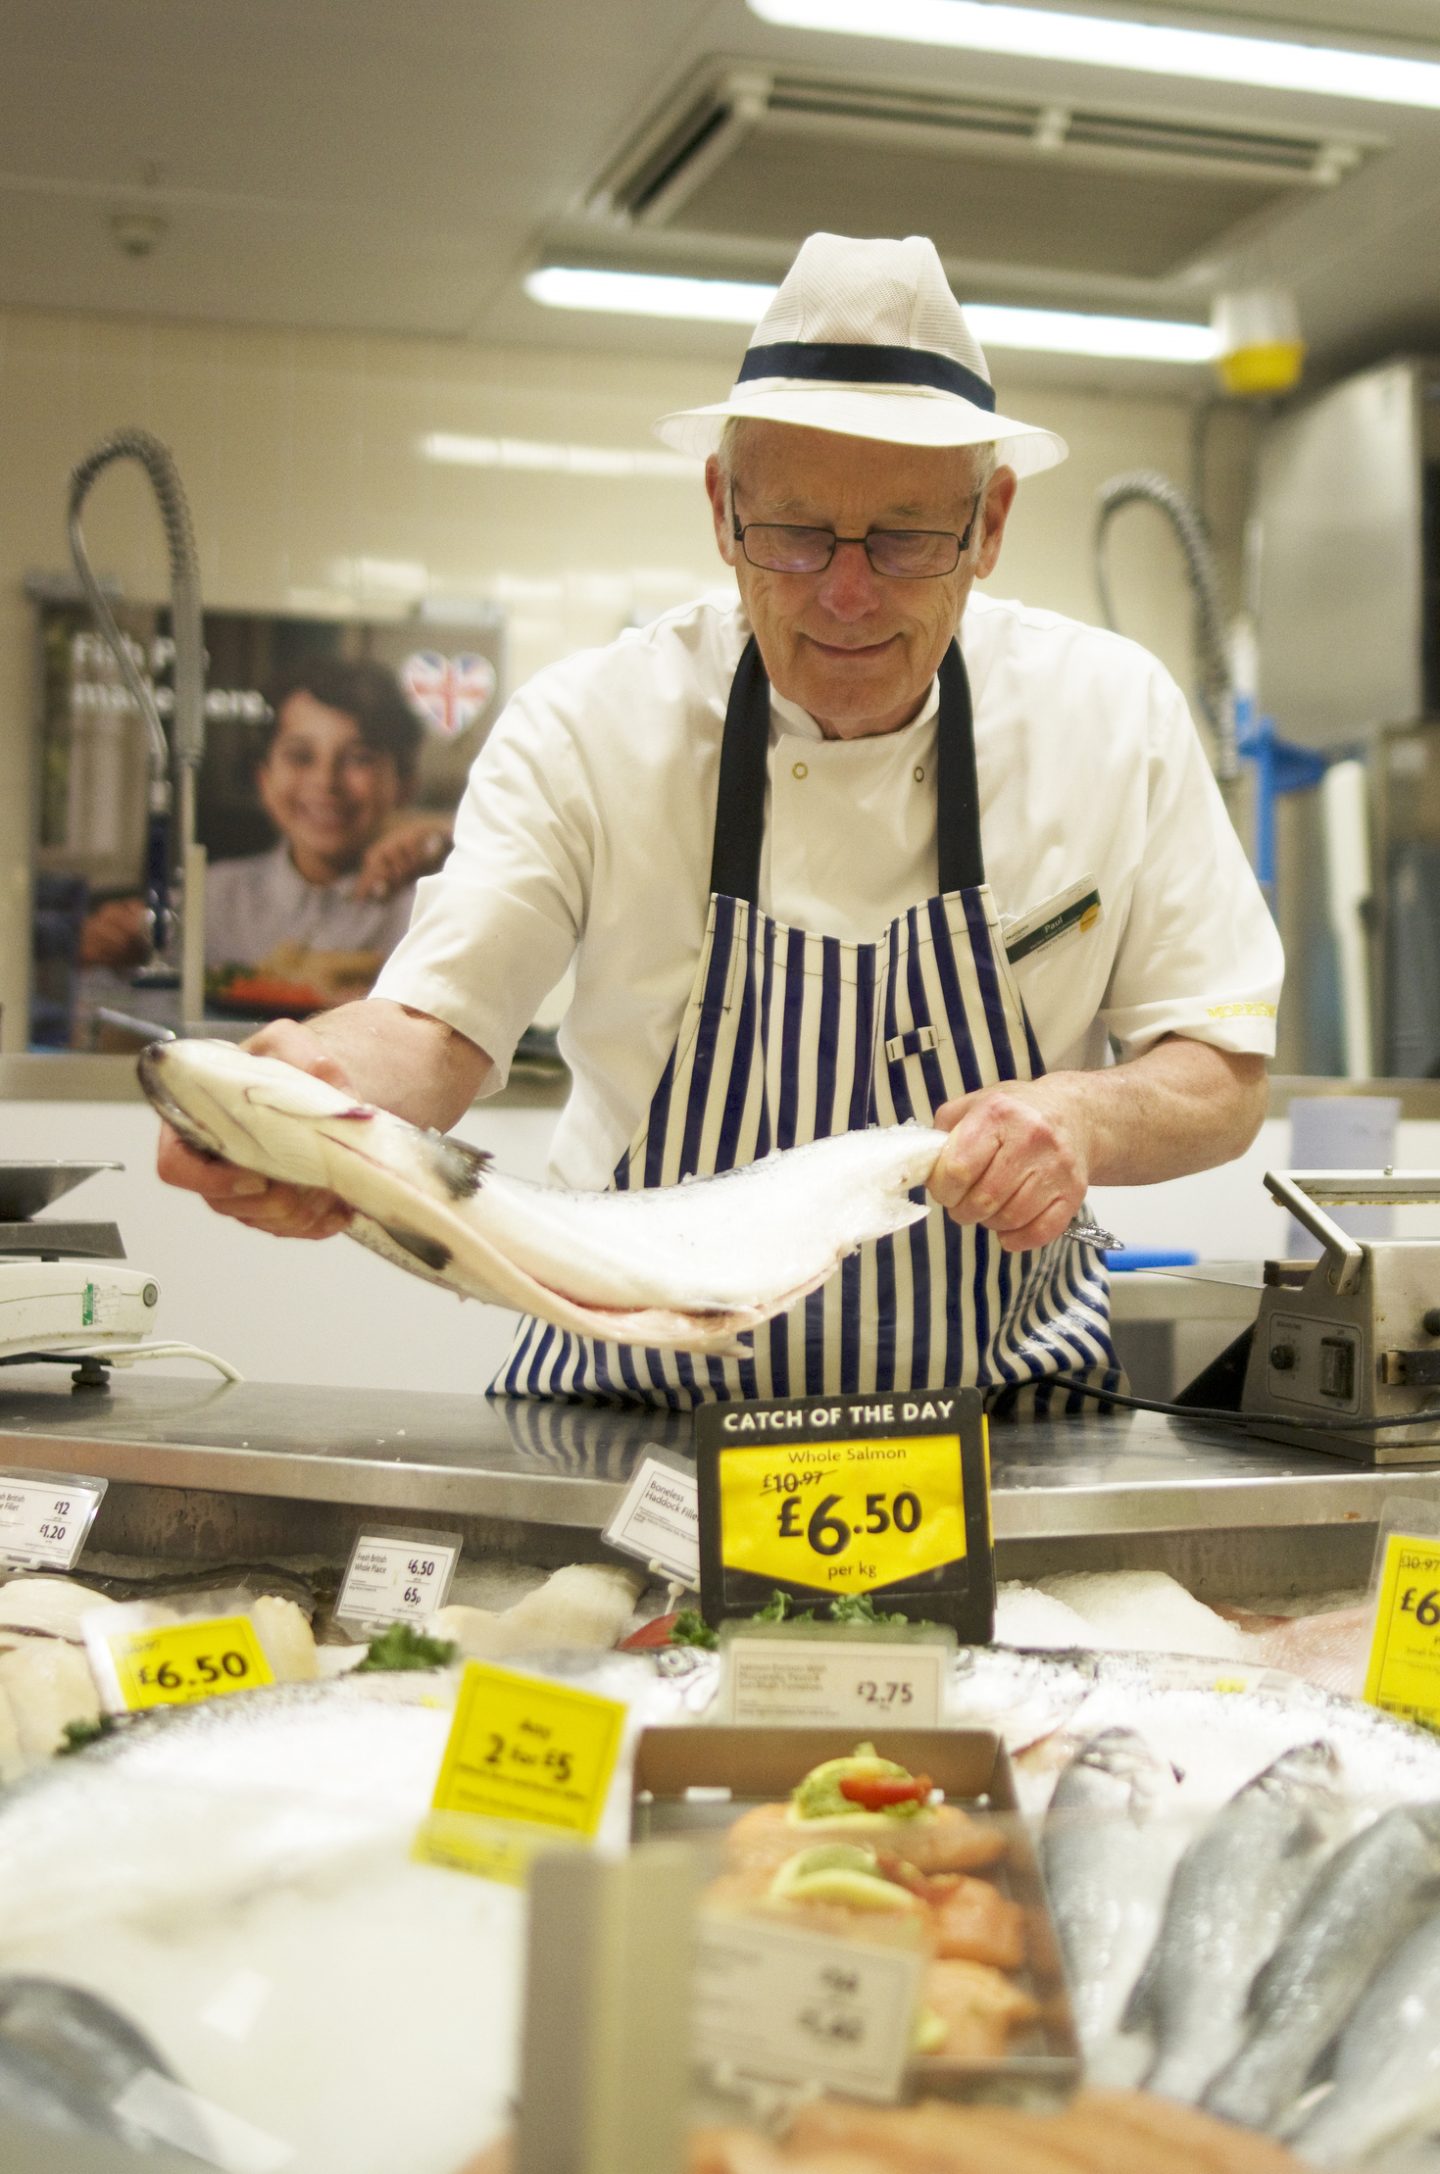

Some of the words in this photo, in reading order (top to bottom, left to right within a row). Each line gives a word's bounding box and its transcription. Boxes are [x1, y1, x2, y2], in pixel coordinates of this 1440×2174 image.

[1044, 916, 1065, 934] Paul
[723, 1410, 803, 1432] CATCH
[810, 1407, 842, 1427] OF
[849, 1404, 895, 1424] THE
[903, 1400, 954, 1422] DAY
[788, 1449, 841, 1464] Whole
[847, 1447, 907, 1462] Salmon
[650, 1480, 686, 1503] Boneless
[54, 1501, 71, 1515] £12
[645, 1491, 683, 1513] Haddock
[681, 1506, 699, 1521] Fille
[40, 1523, 66, 1540] £1.20
[776, 1491, 922, 1556] £6.50
[407, 1558, 435, 1576] £6.50
[827, 1566, 853, 1580] per
[859, 1562, 877, 1578] kg
[404, 1586, 421, 1605] 65p
[138, 1650, 249, 1690] £6.50
[857, 1680, 914, 1704] £2.75
[484, 1732, 505, 1765] 2
